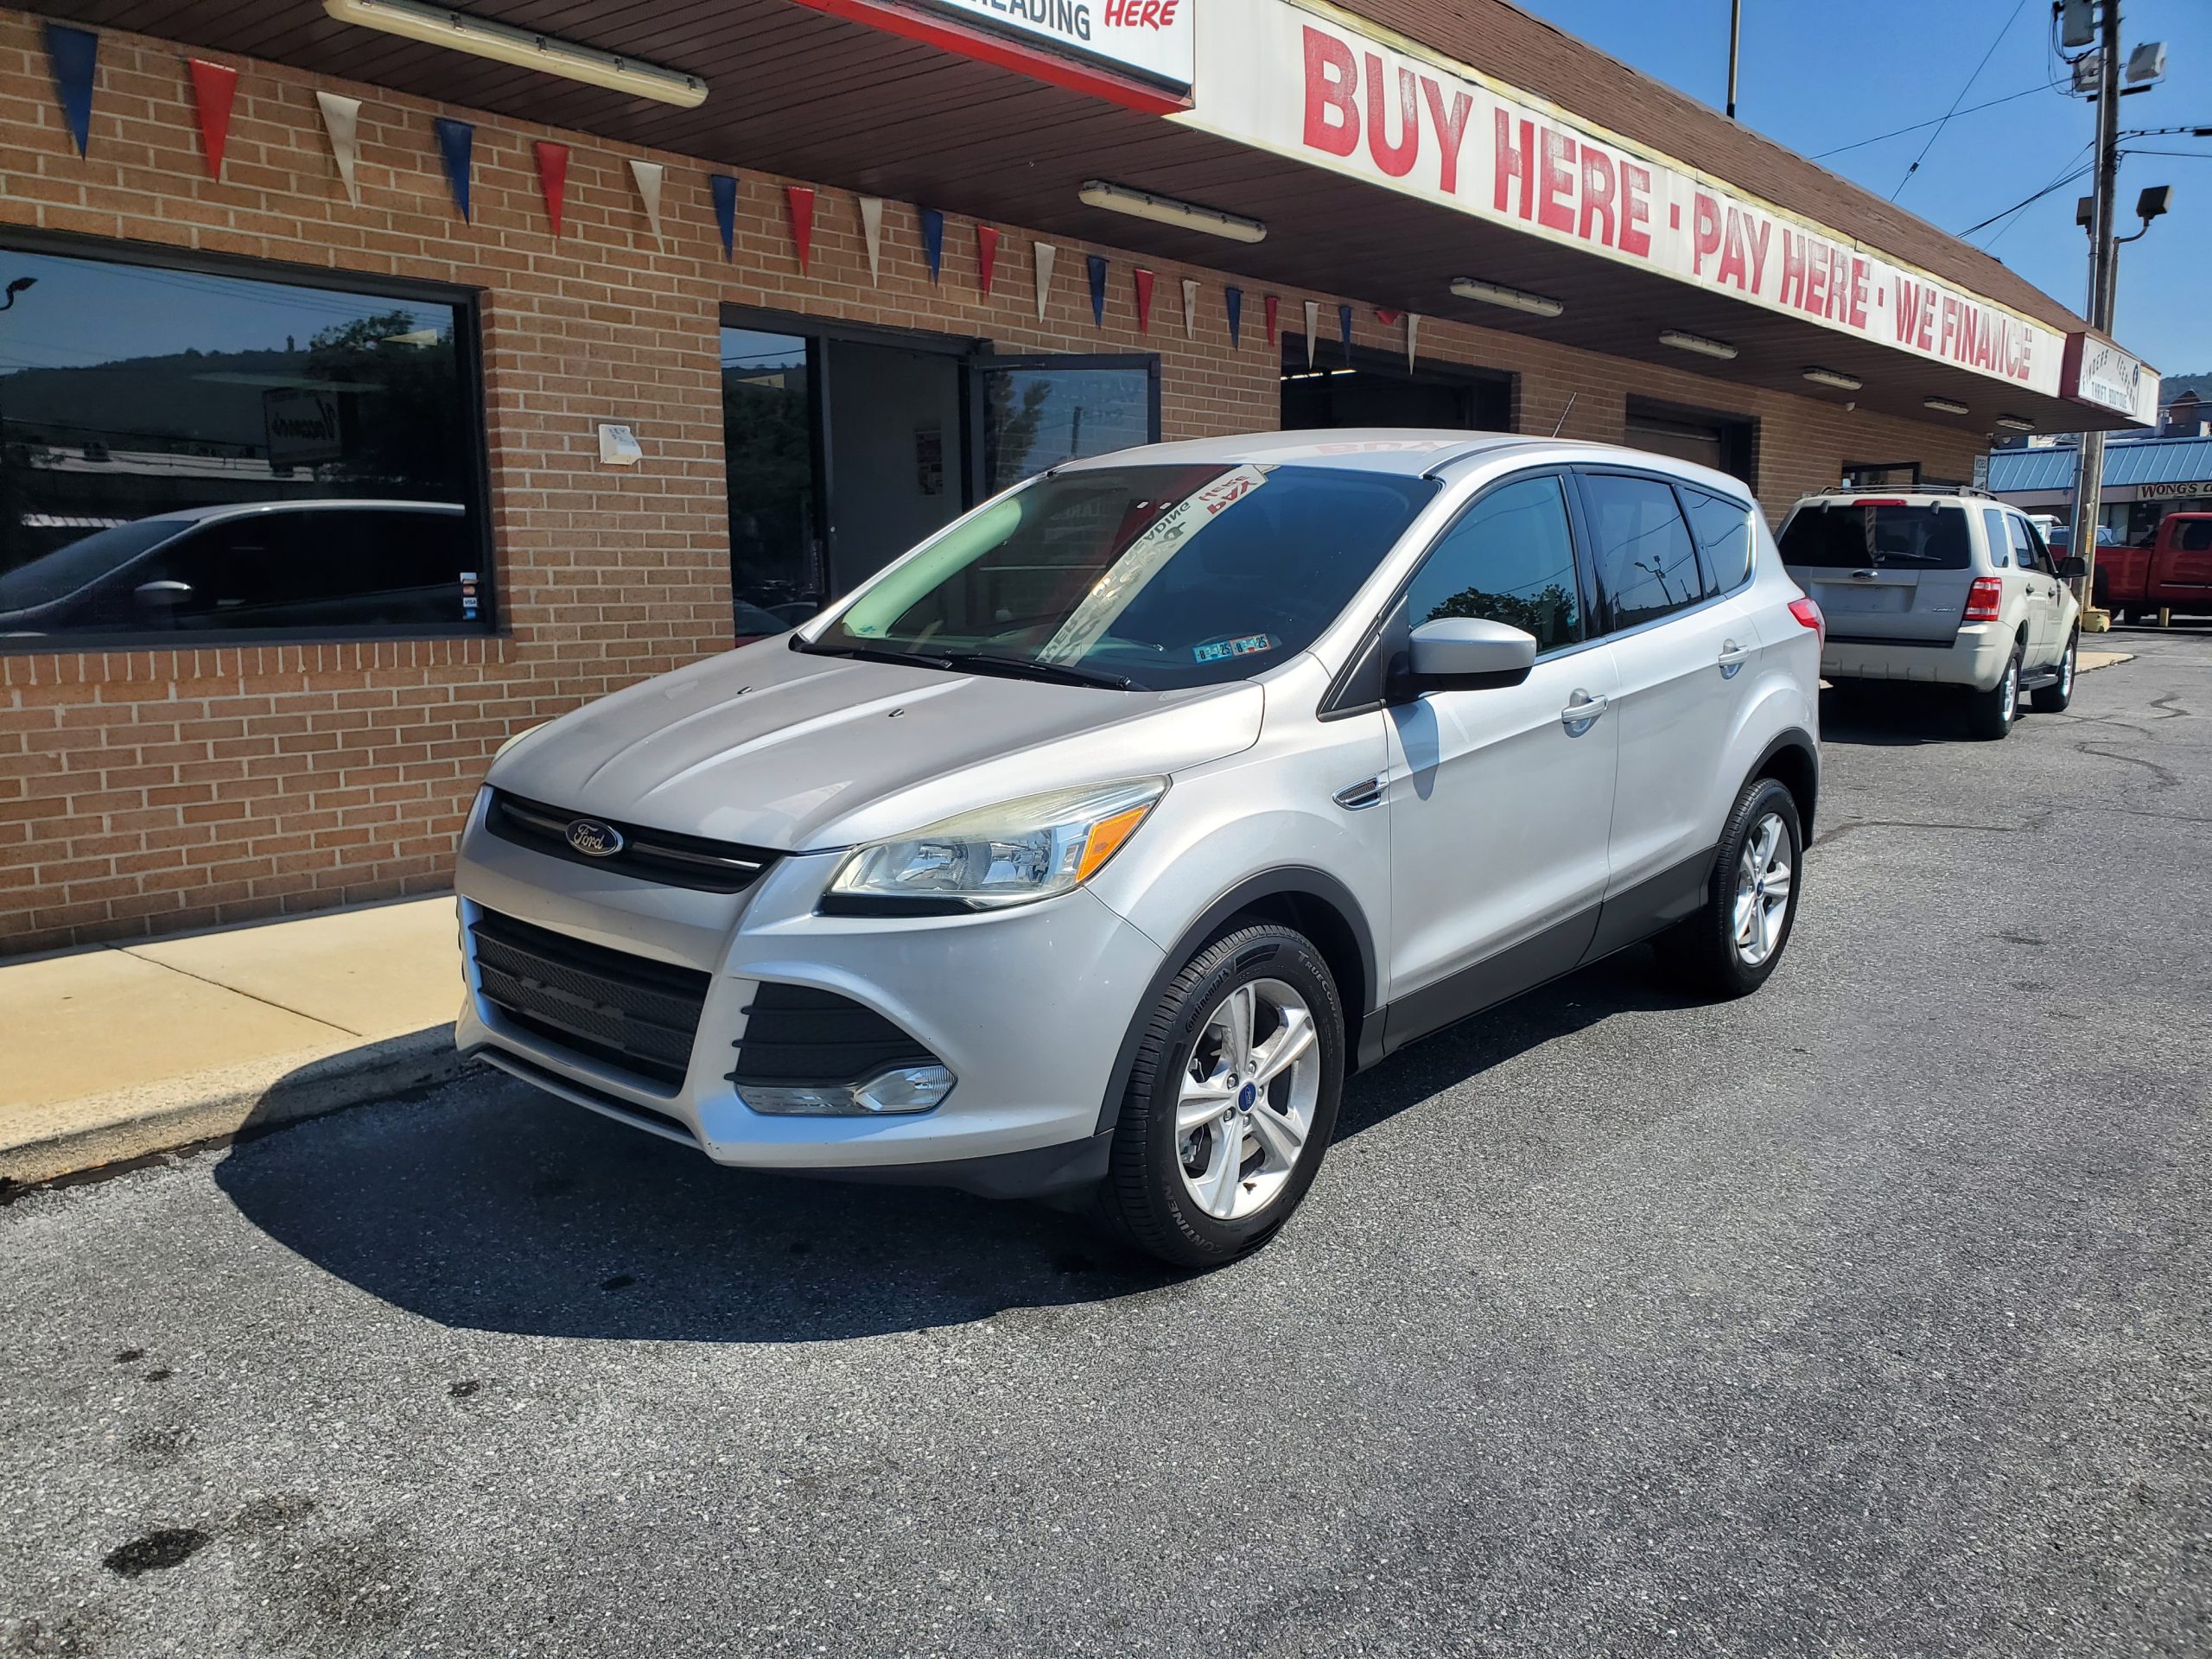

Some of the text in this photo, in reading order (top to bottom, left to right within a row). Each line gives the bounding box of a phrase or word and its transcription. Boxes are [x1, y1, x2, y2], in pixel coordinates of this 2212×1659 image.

[1104, 0, 1179, 31] HERE
[1302, 25, 2032, 381] BUY HERE PAY HERE WE FINANCE
[2082, 348, 2109, 392] FINDERS
[2142, 483, 2198, 498] WONG'S
[1220, 643, 1231, 655] 25
[1256, 636, 1268, 648] 25
[574, 823, 605, 849] Ford
